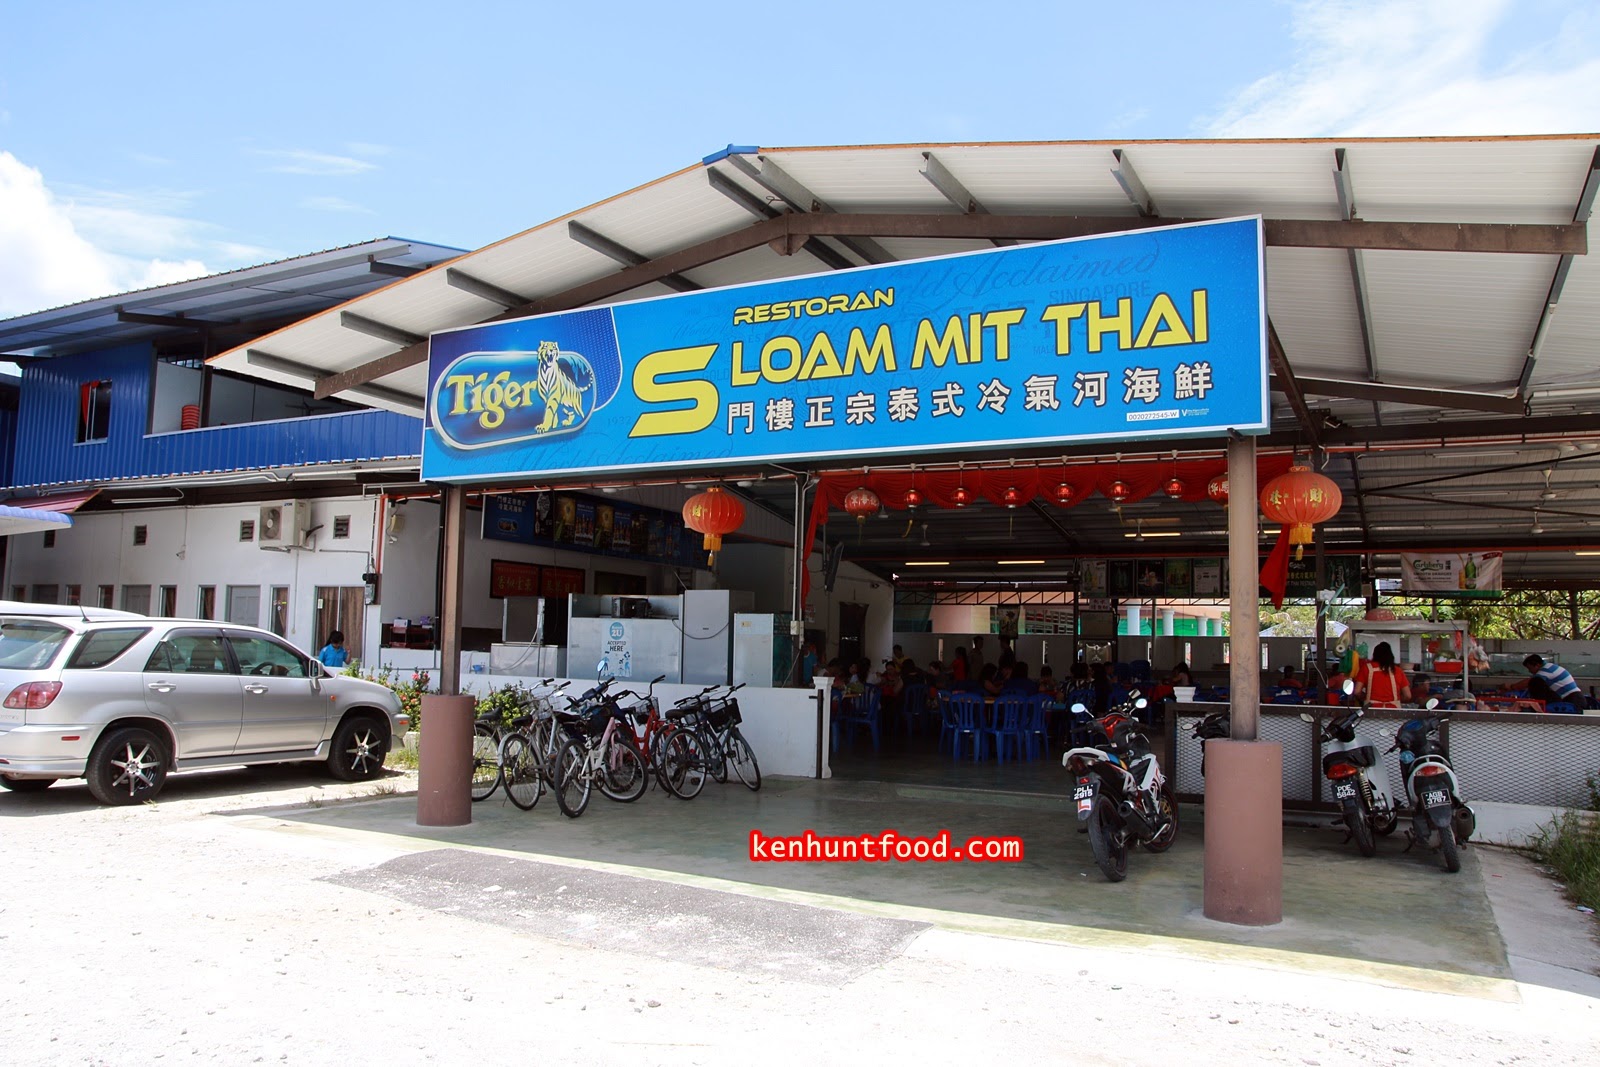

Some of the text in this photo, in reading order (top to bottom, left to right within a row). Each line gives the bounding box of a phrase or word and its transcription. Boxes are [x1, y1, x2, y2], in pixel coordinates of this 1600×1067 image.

[732, 288, 894, 325] RESTORAN
[730, 325, 897, 387] LOAM
[911, 308, 1025, 369] MIT
[1042, 289, 1208, 357] THAI
[446, 370, 538, 430] Tiger
